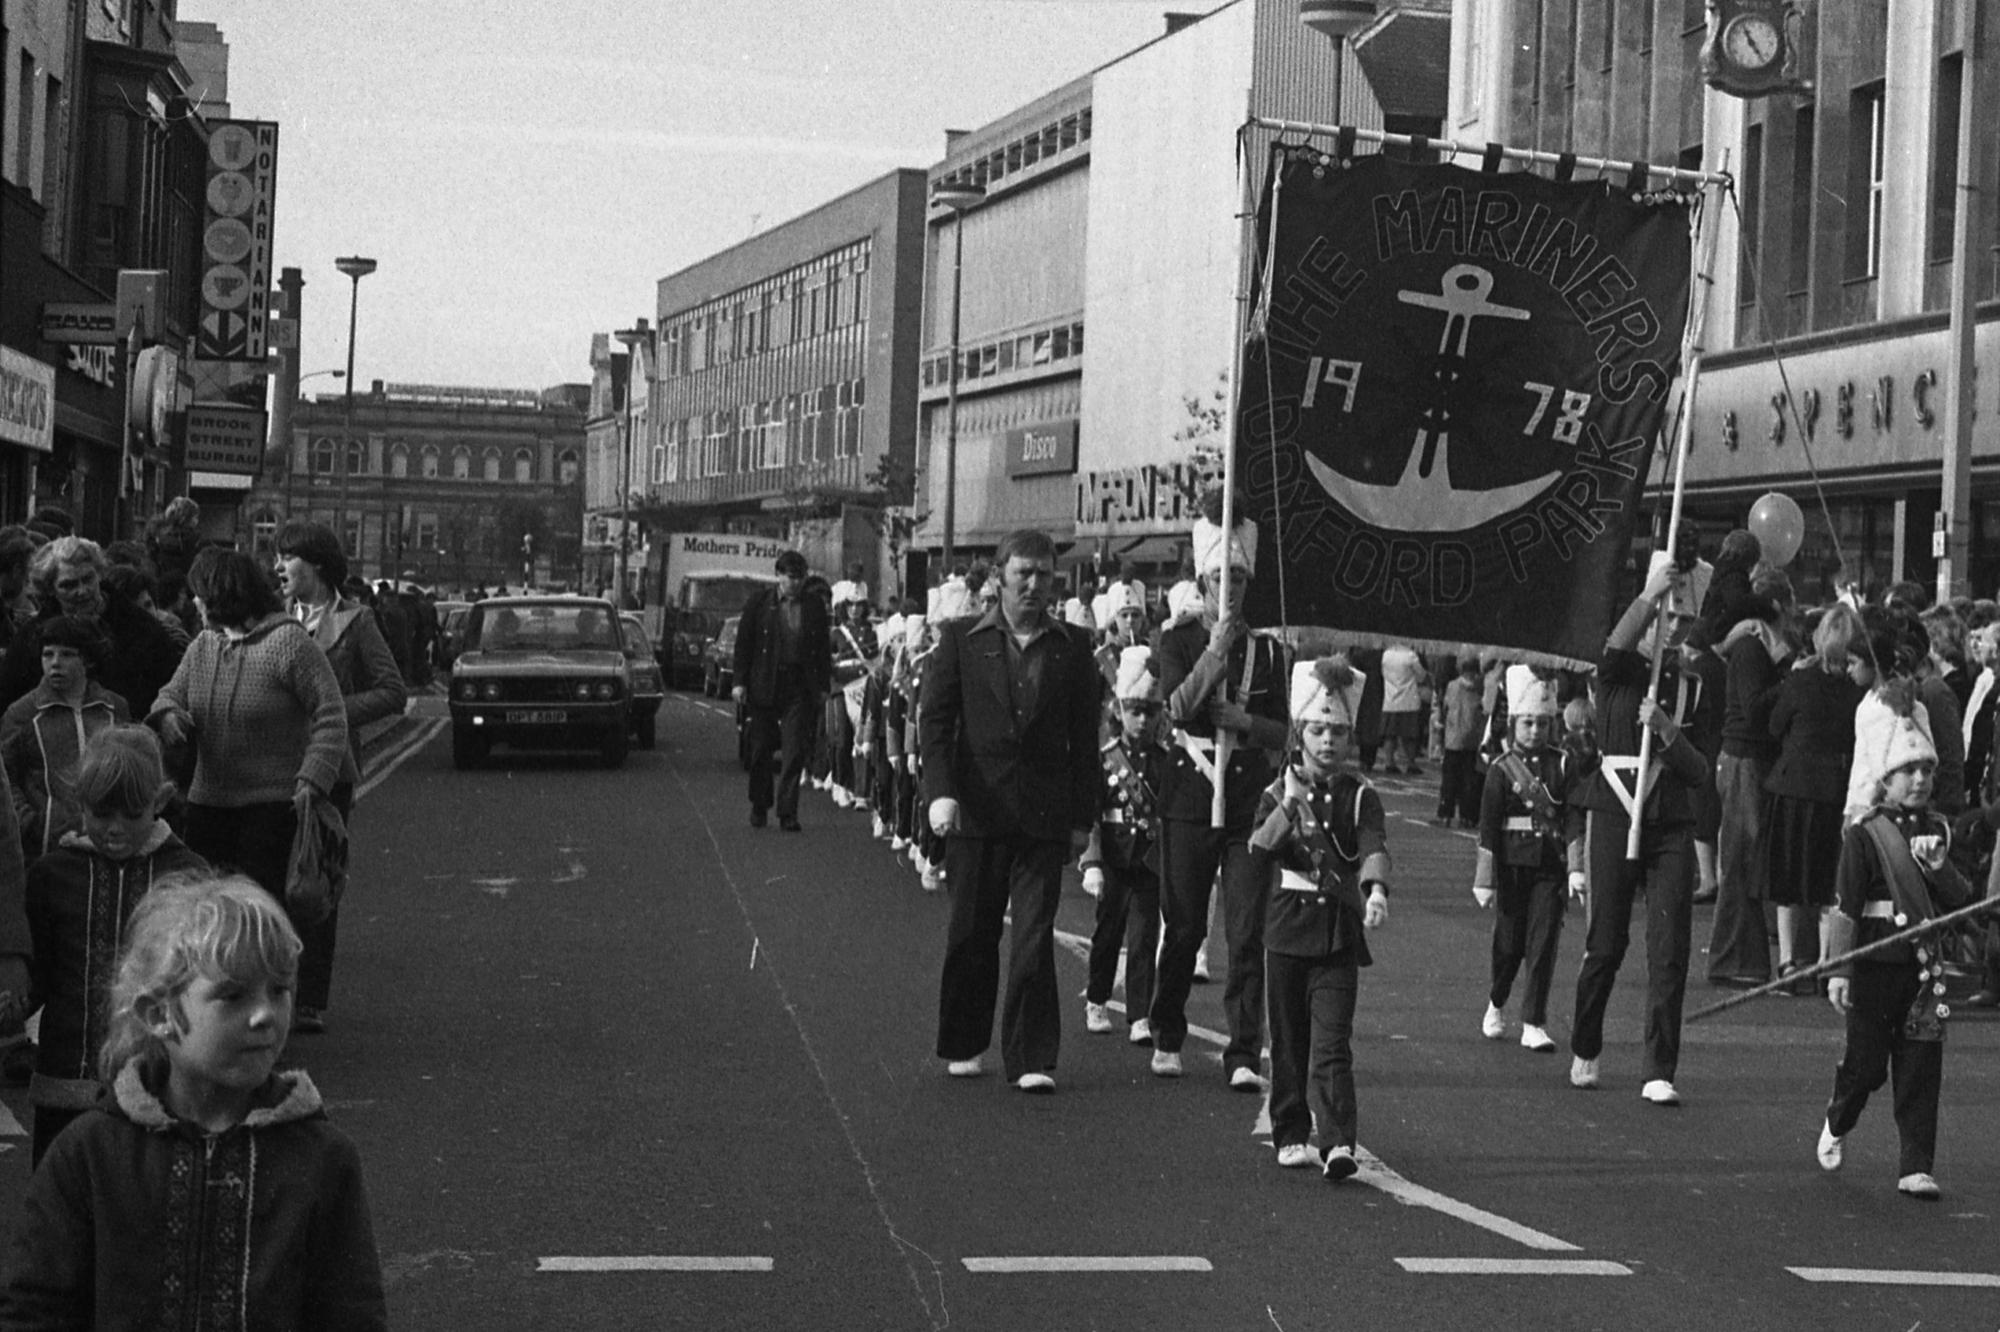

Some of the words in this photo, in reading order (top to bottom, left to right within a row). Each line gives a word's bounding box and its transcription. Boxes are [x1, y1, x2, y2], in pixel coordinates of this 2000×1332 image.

[247, 128, 273, 357] NOTARIANNI
[1249, 235, 1368, 363] THE
[1371, 185, 1669, 405] MARINERS
[191, 416, 252, 430] BROOK
[1301, 356, 1363, 413] 19
[1522, 380, 1591, 445] 78
[1768, 368, 1976, 447] SPENC
[188, 450, 257, 465] BUREAU
[189, 433, 254, 448] STREET
[1022, 431, 1057, 462] Disco
[1241, 395, 1474, 609] DOXFORD
[1498, 421, 1646, 584] PARK
[683, 537, 740, 555] Mothers
